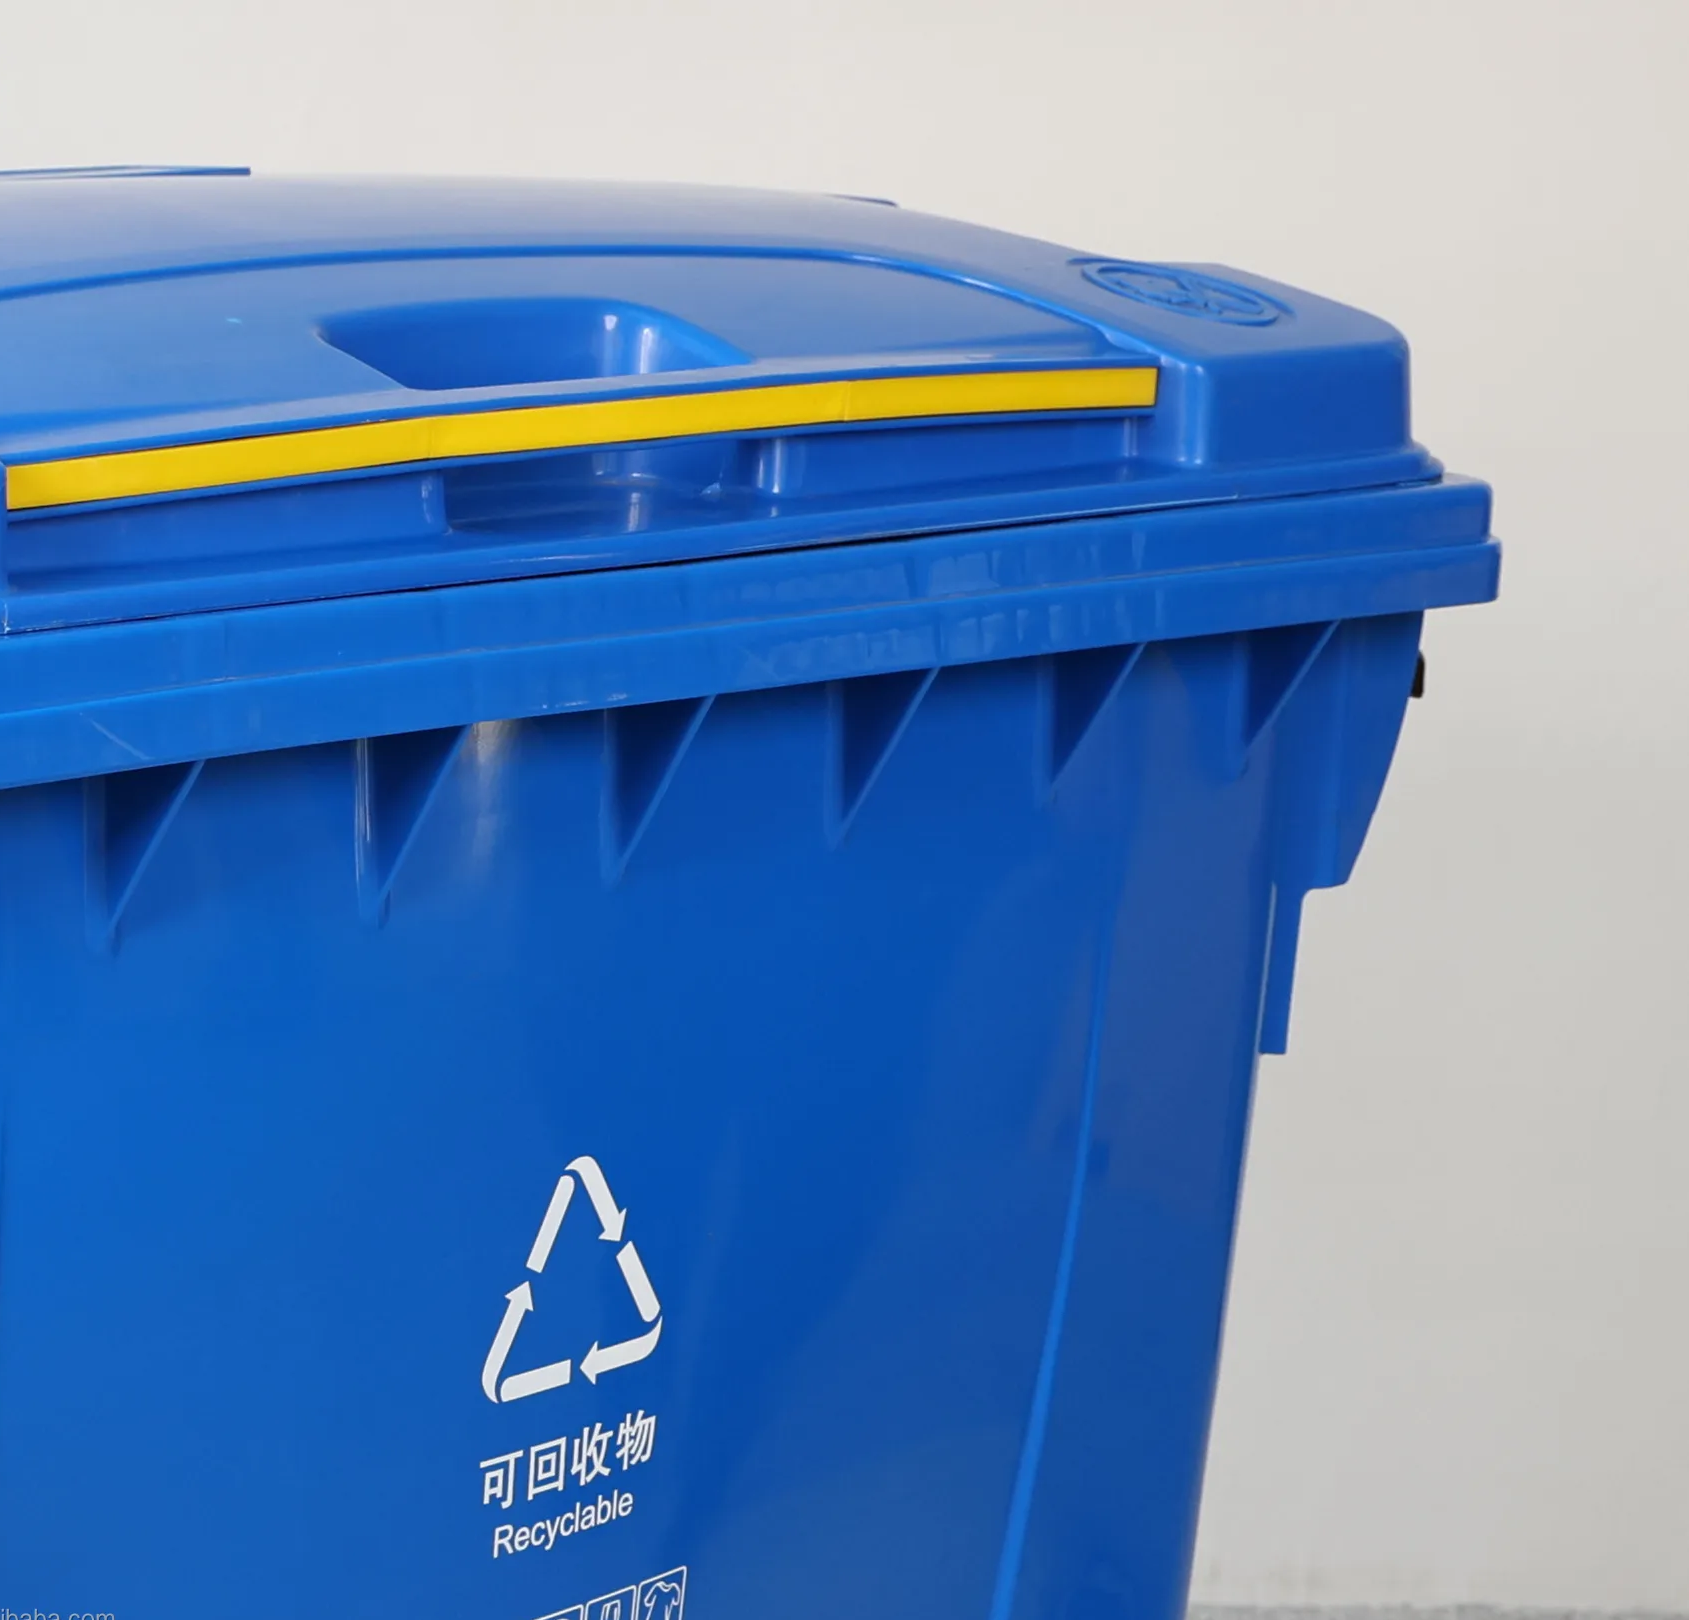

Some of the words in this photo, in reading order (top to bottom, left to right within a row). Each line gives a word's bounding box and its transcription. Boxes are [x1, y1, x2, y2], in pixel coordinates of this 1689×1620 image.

[479, 1409, 657, 1510] 可回收物
[492, 1488, 634, 1559] Recyclable
